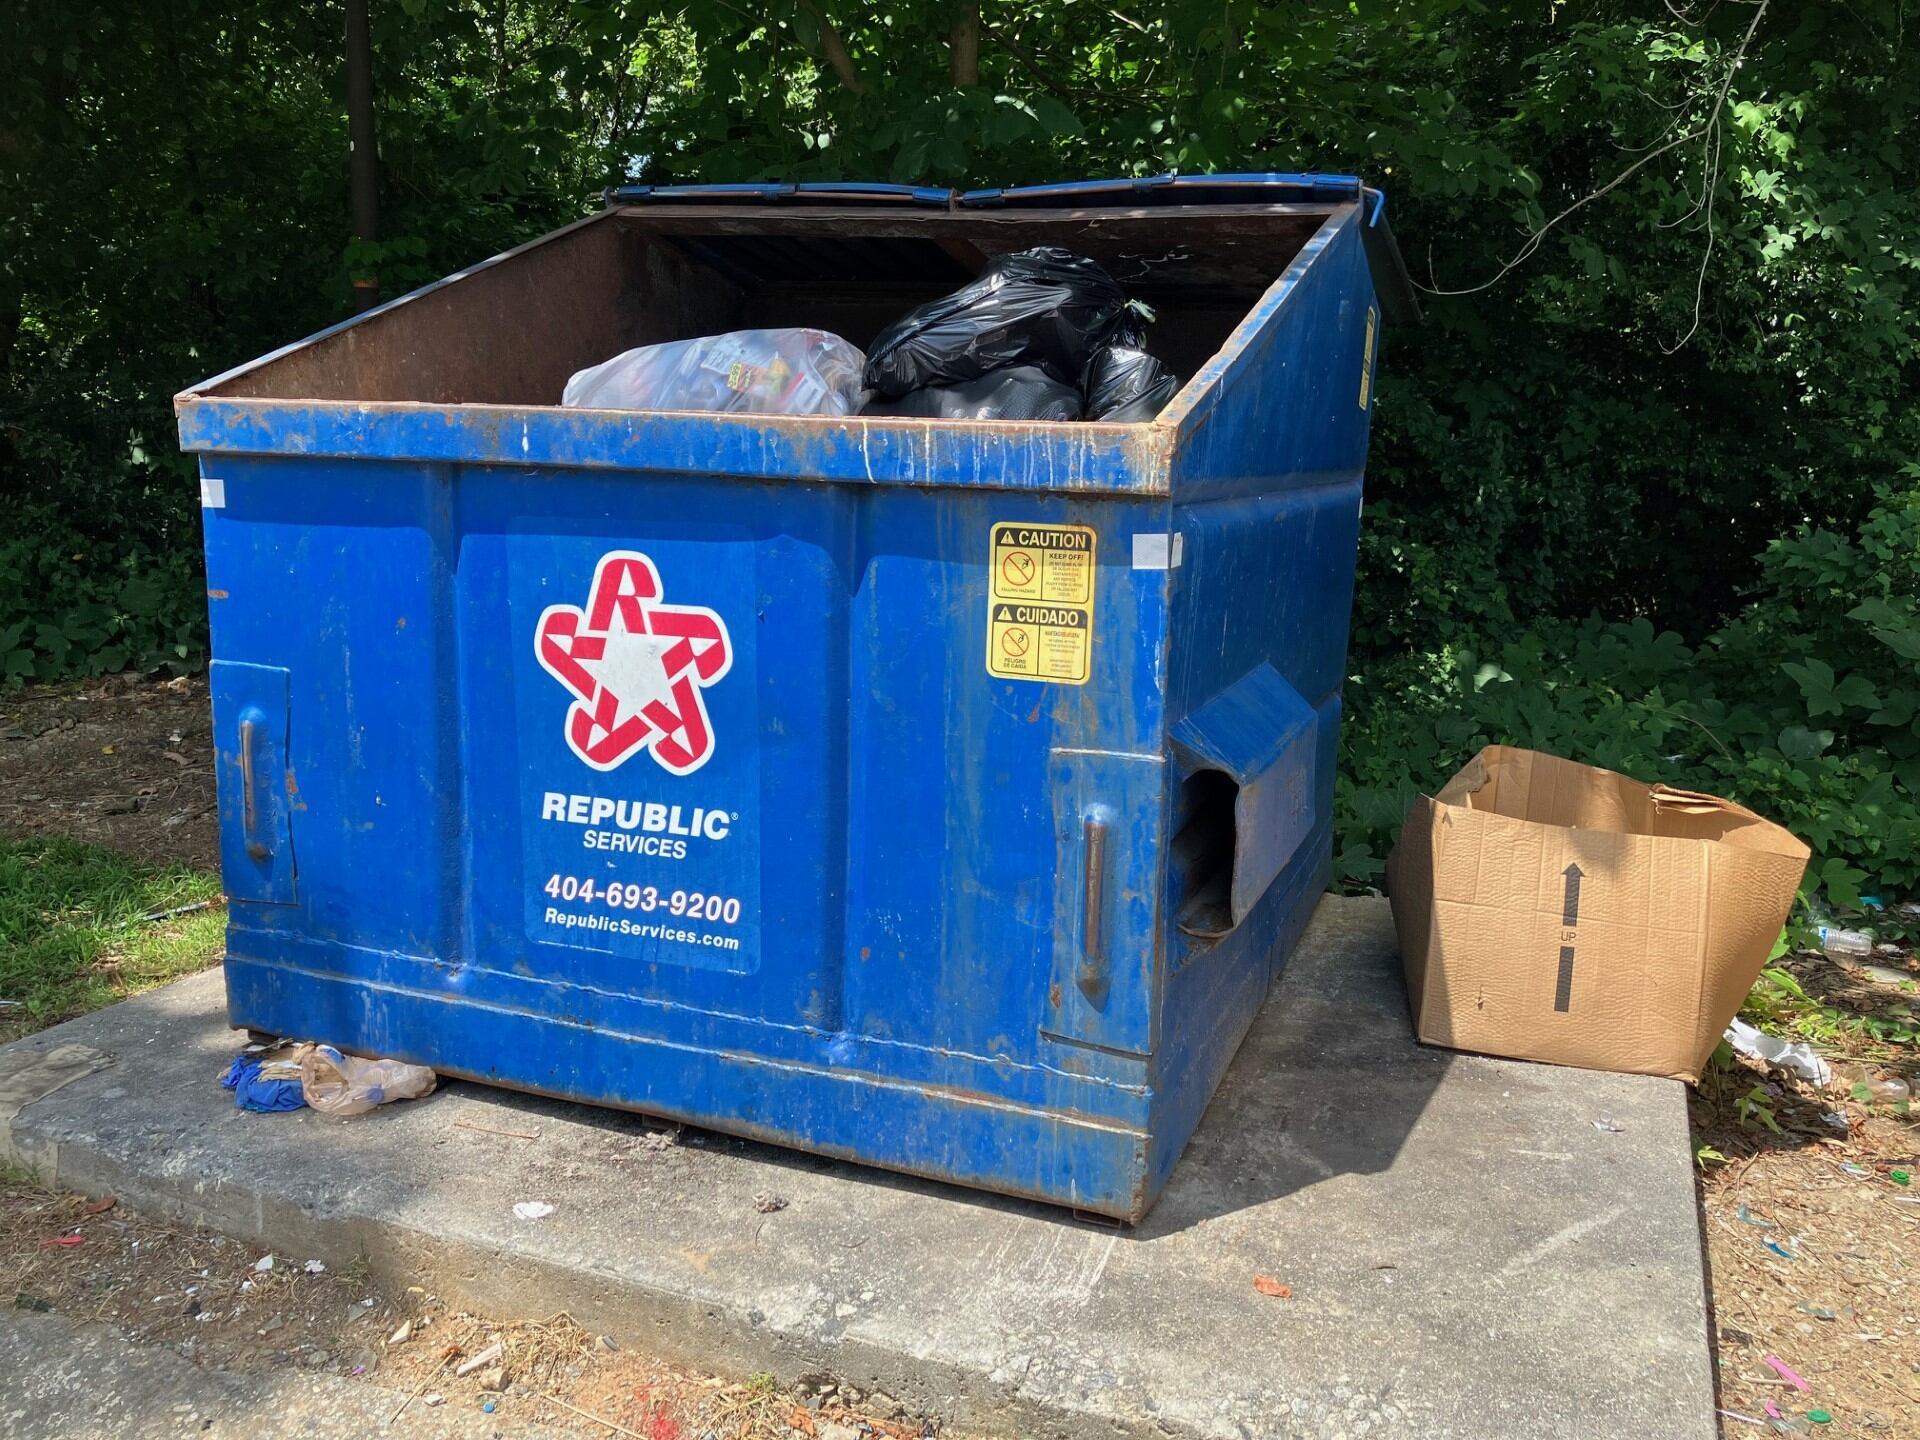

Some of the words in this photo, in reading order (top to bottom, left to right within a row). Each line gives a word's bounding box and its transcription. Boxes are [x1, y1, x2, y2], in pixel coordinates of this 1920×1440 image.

[1018, 530, 1086, 549] CAUTION
[1016, 606, 1079, 626] CUIDADO
[582, 829, 688, 860] SERVICES
[544, 873, 741, 925] 404-693-9200
[544, 907, 740, 951] RepublicServices.com
[1560, 931, 1577, 942] UP
